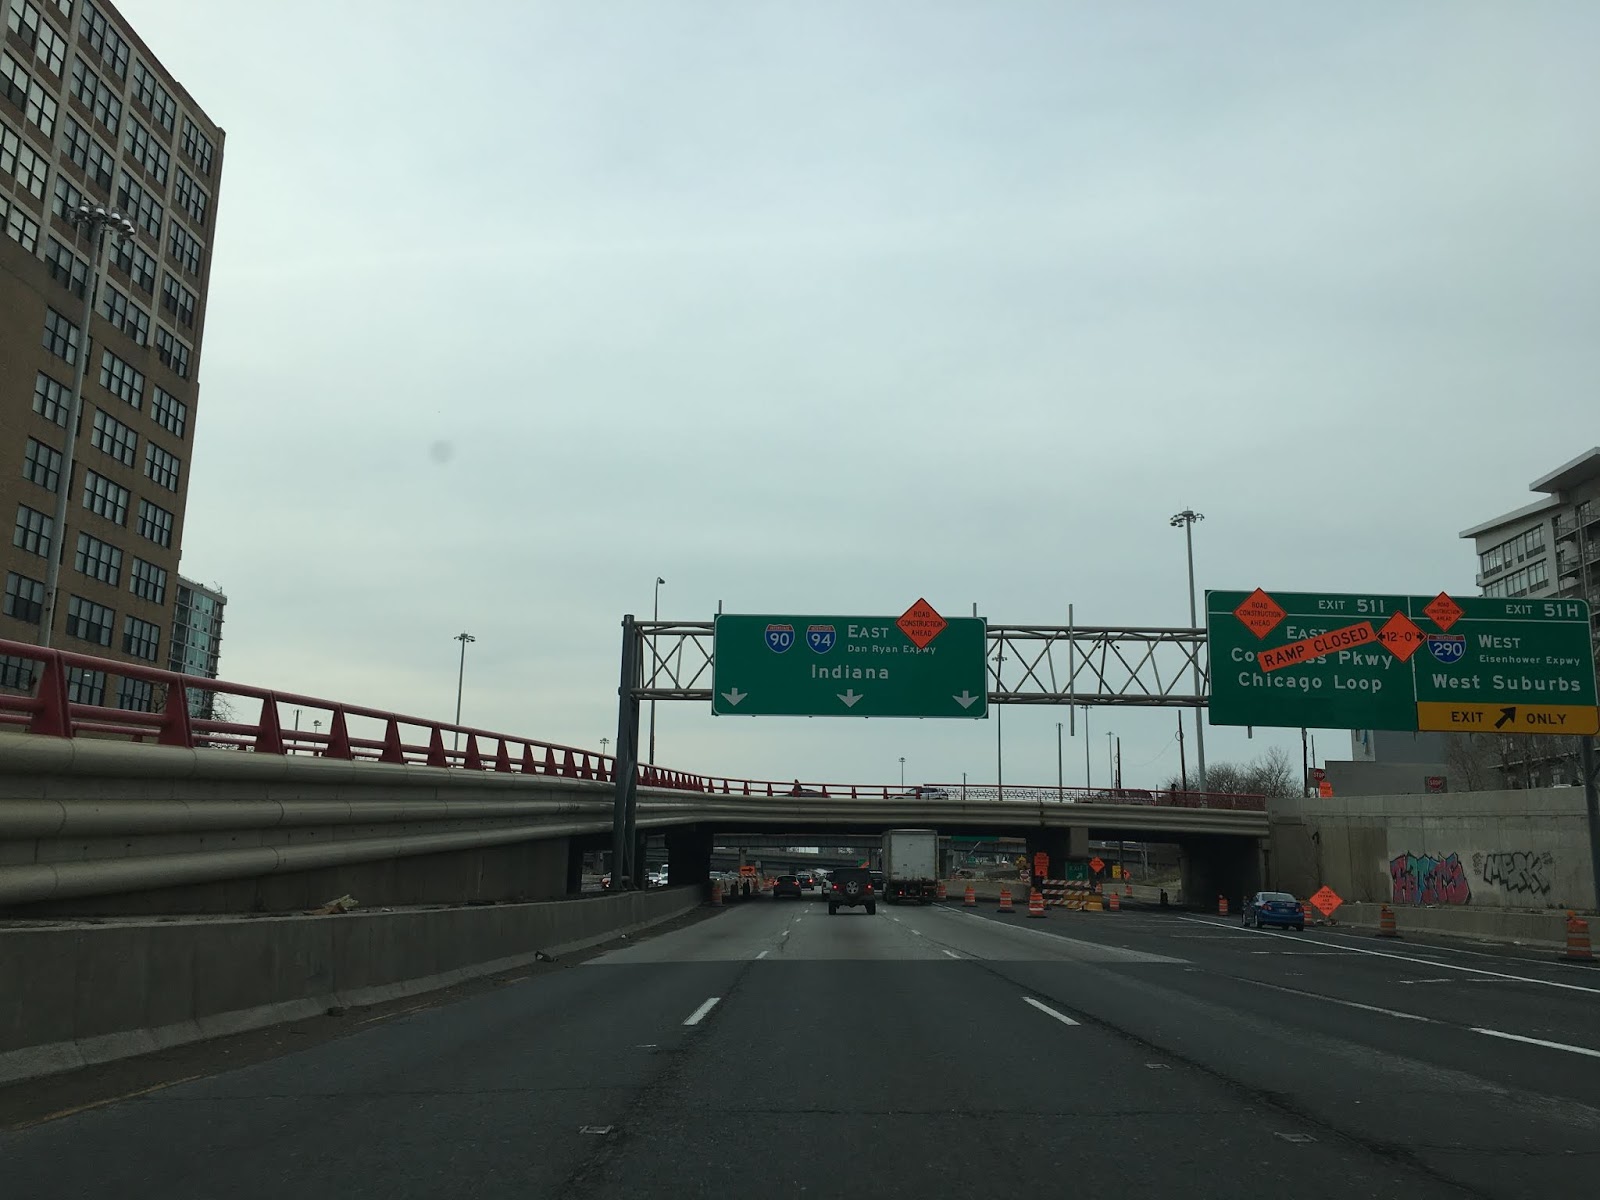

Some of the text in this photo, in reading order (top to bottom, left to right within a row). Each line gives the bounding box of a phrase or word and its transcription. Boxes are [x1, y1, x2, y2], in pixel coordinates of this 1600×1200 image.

[1251, 601, 1268, 609] ROAD
[1318, 600, 1346, 610] EXIT
[1505, 603, 1579, 618] EXIT 51H
[913, 610, 931, 618] ROAD
[1239, 609, 1281, 618] CONSTRUCTION
[847, 624, 889, 638] EAST
[900, 620, 943, 628] CONSTRUCTION
[770, 632, 790, 647] 90
[811, 633, 832, 647] 94
[912, 629, 932, 637] AHEAD
[1263, 627, 1370, 668] RAMP CLOSED
[1478, 634, 1521, 649] WEST
[847, 644, 868, 653] Dan
[872, 644, 898, 655] Ryan
[1433, 642, 1463, 657] 290
[1338, 651, 1394, 670] Pkwy
[1479, 654, 1581, 667] Eisenhower Expwy
[811, 664, 889, 680] Indiana
[1238, 672, 1383, 694] Chicago Loop
[1432, 673, 1581, 693] West Suburbs
[1451, 711, 1567, 725] EXIT ONLY
